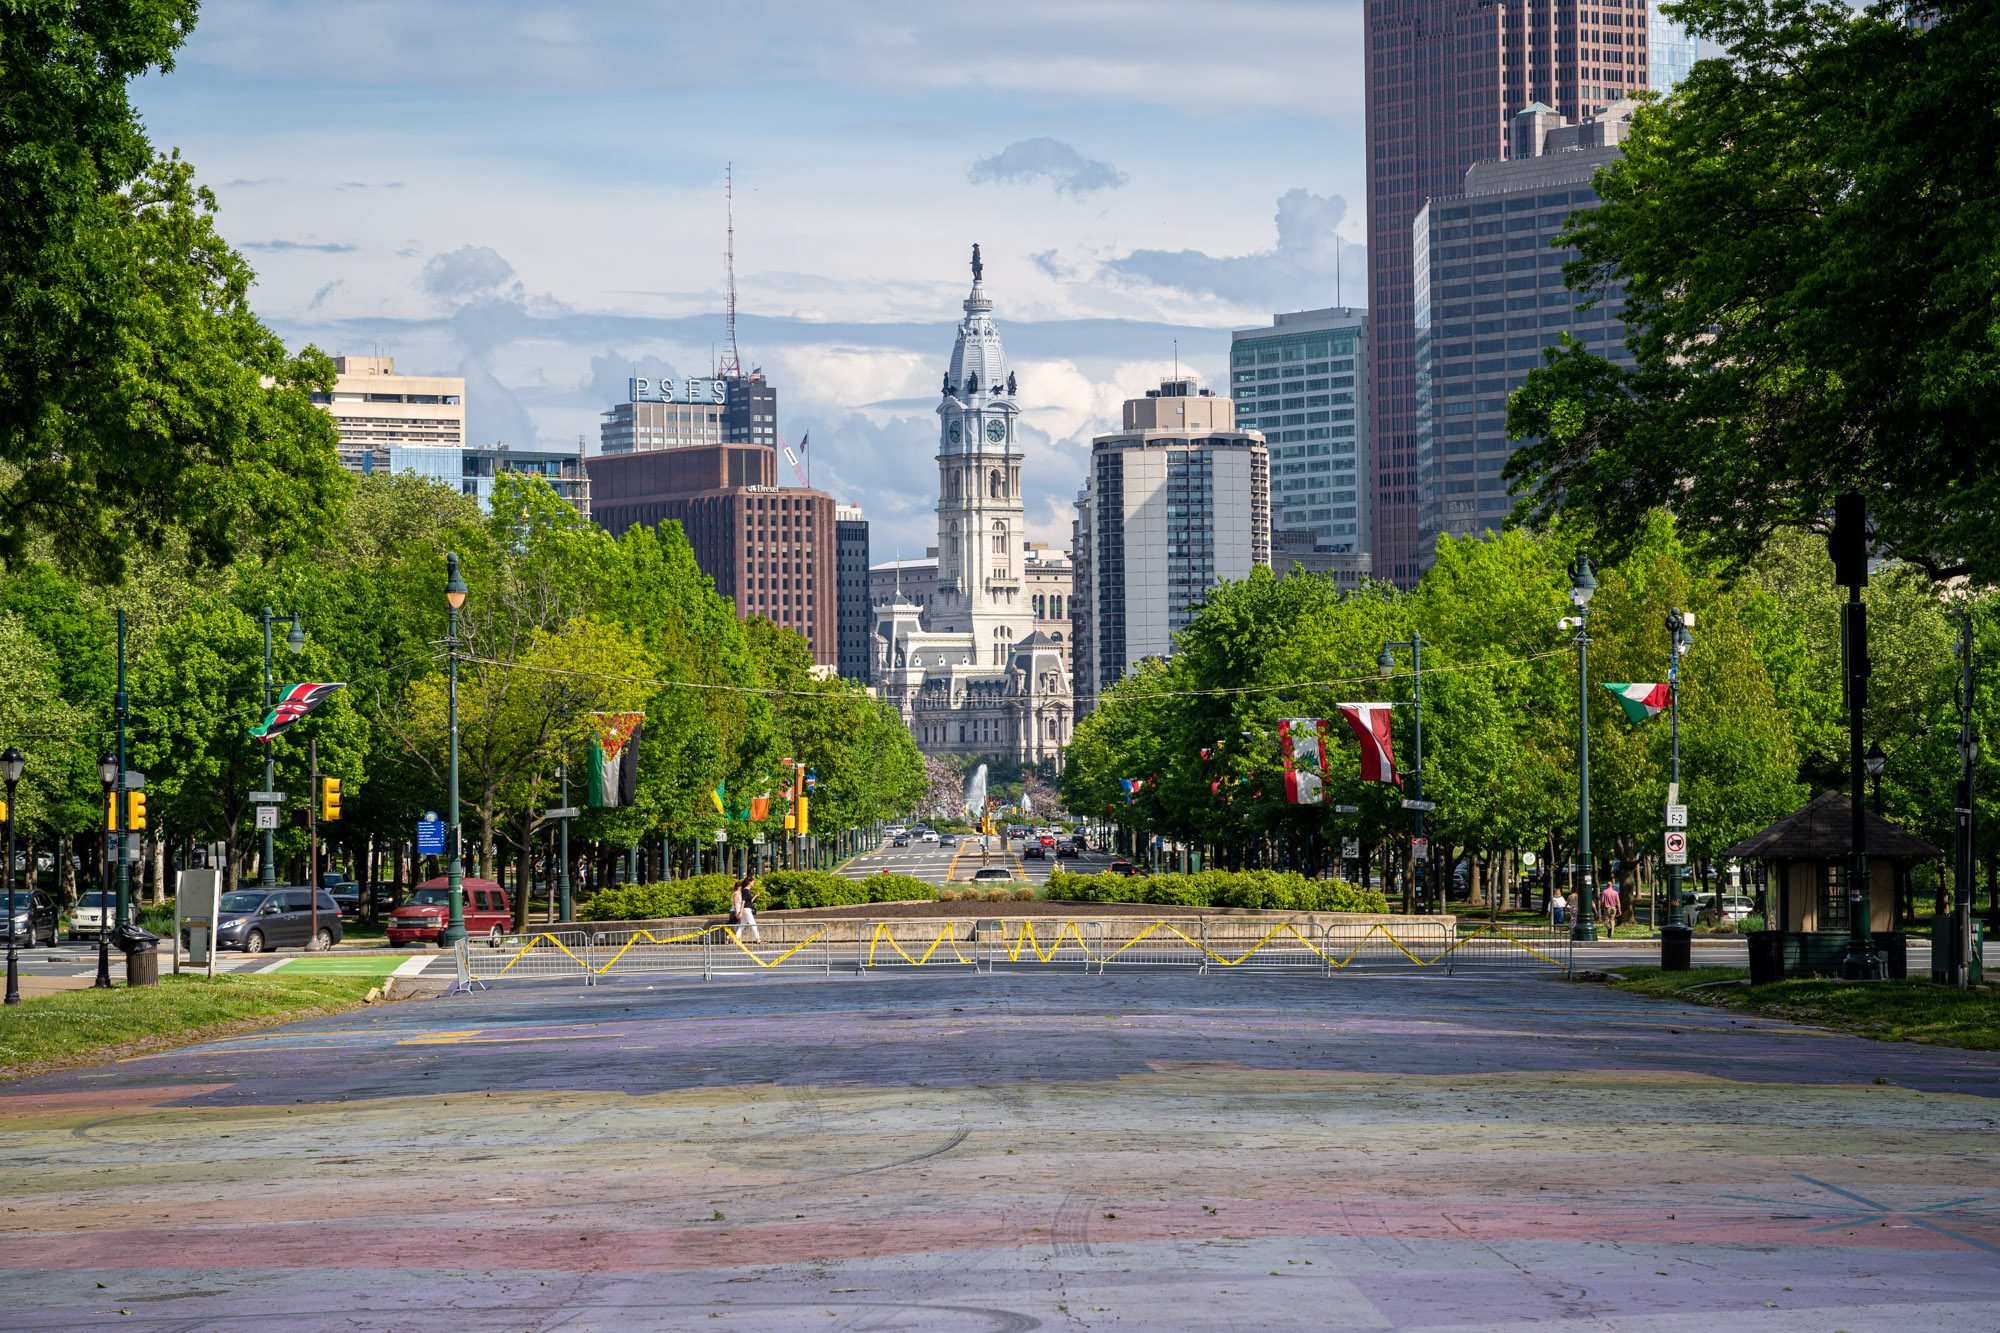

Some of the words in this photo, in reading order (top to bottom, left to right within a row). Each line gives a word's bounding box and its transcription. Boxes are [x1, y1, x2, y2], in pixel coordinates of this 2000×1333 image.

[636, 377, 726, 405] PSFS
[757, 484, 779, 493] Drexel
[261, 816, 272, 827] F-1
[1671, 814, 1683, 824] F-2
[1344, 847, 1357, 856] 25
